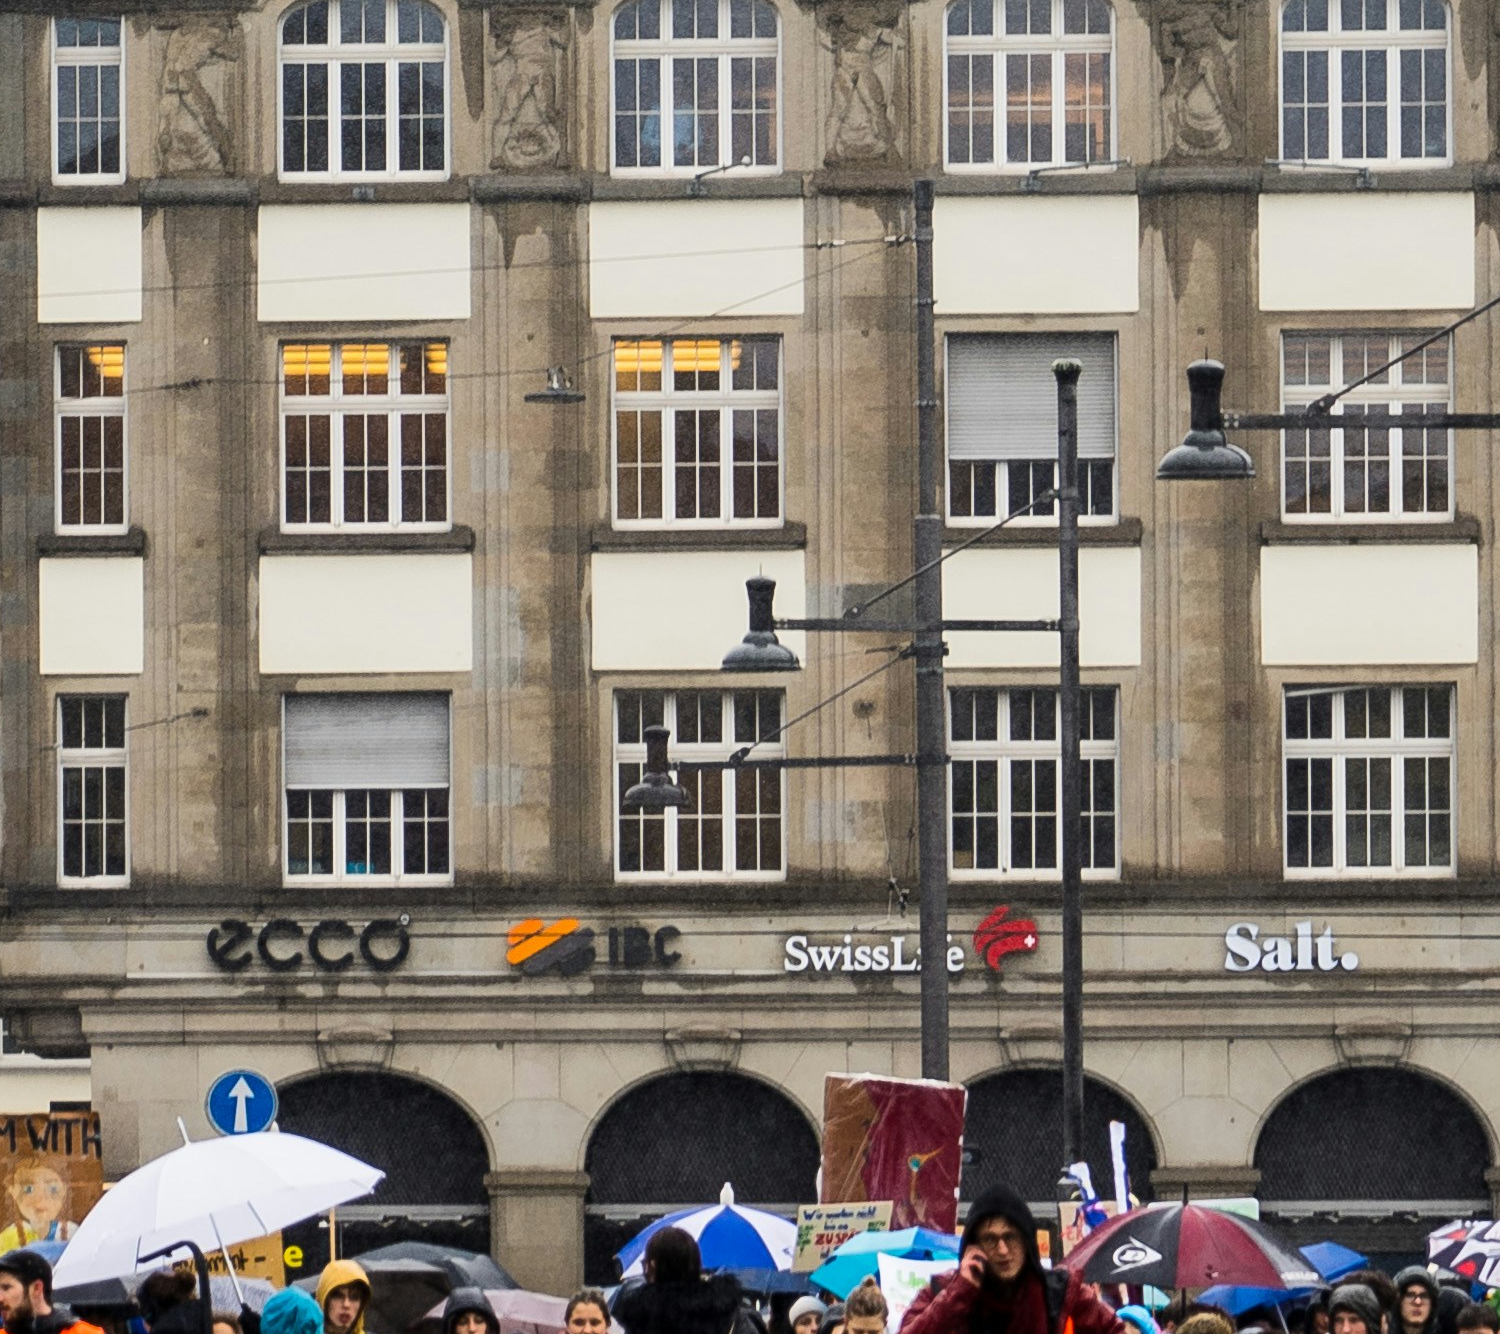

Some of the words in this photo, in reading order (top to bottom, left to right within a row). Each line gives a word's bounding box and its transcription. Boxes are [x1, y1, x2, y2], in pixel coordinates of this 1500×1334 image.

[207, 919, 411, 971] ecco
[609, 926, 682, 967] IBC
[784, 934, 964, 972] SwissLe
[1223, 921, 1358, 972] Salt.
[26, 1118, 101, 1160] WITH
